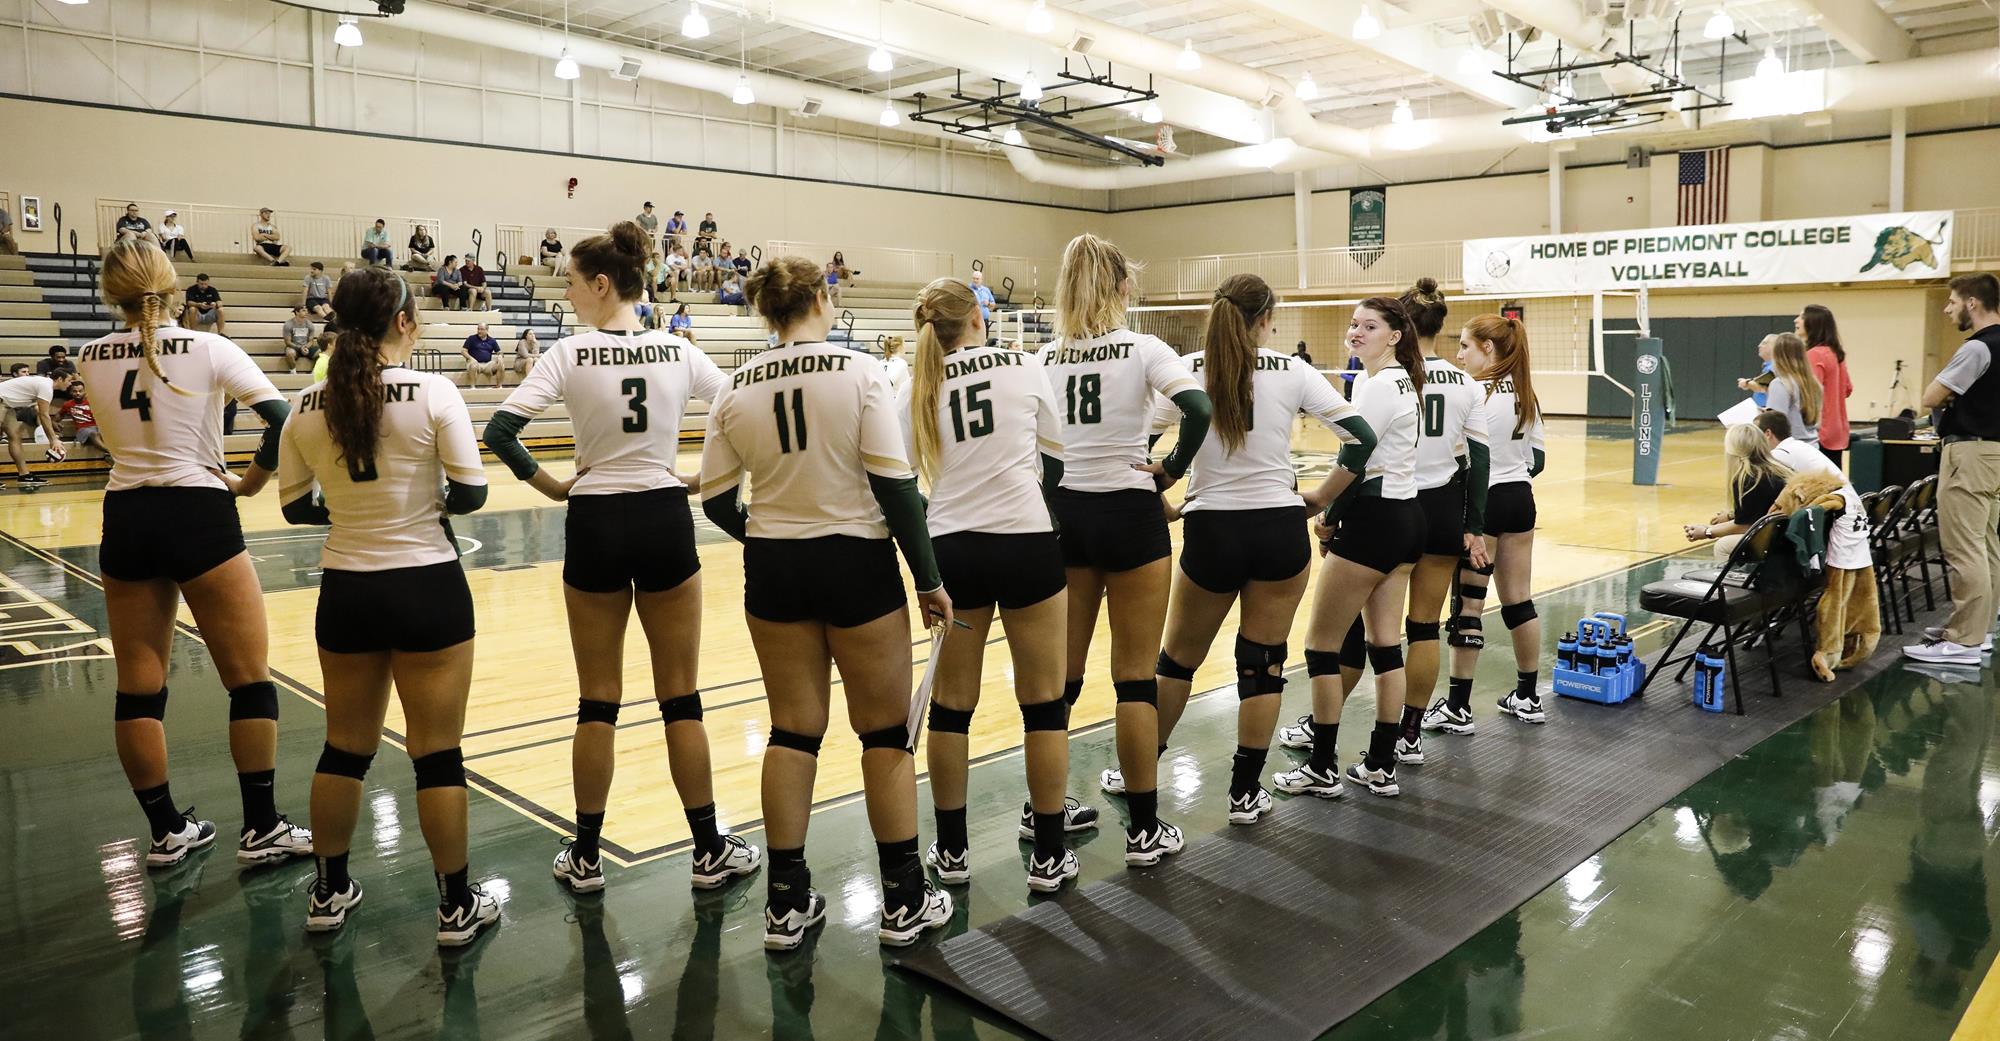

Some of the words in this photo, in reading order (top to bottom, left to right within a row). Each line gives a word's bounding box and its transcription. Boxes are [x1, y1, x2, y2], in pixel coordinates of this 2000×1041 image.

[1530, 241, 1587, 259] HOME
[1593, 239, 1618, 256] OF
[1624, 232, 1737, 254] PIEDMONT
[1744, 225, 1851, 248] COLLEGE
[1611, 260, 1748, 281] VOLLEYBALL
[82, 338, 194, 362] PIEDMNT
[576, 345, 681, 366] PIEDMONT
[945, 352, 1024, 380] DMONT
[732, 354, 851, 391] PIEDMONT
[1424, 370, 1465, 386] MONT
[1483, 380, 1515, 395] PIED
[120, 369, 153, 422] 4
[622, 377, 648, 433] 3
[949, 381, 994, 443] 15
[1066, 373, 1101, 425] 18
[773, 387, 807, 454] 11
[1638, 383, 1652, 456] LIONS
[1557, 679, 1602, 693] POWERADE
